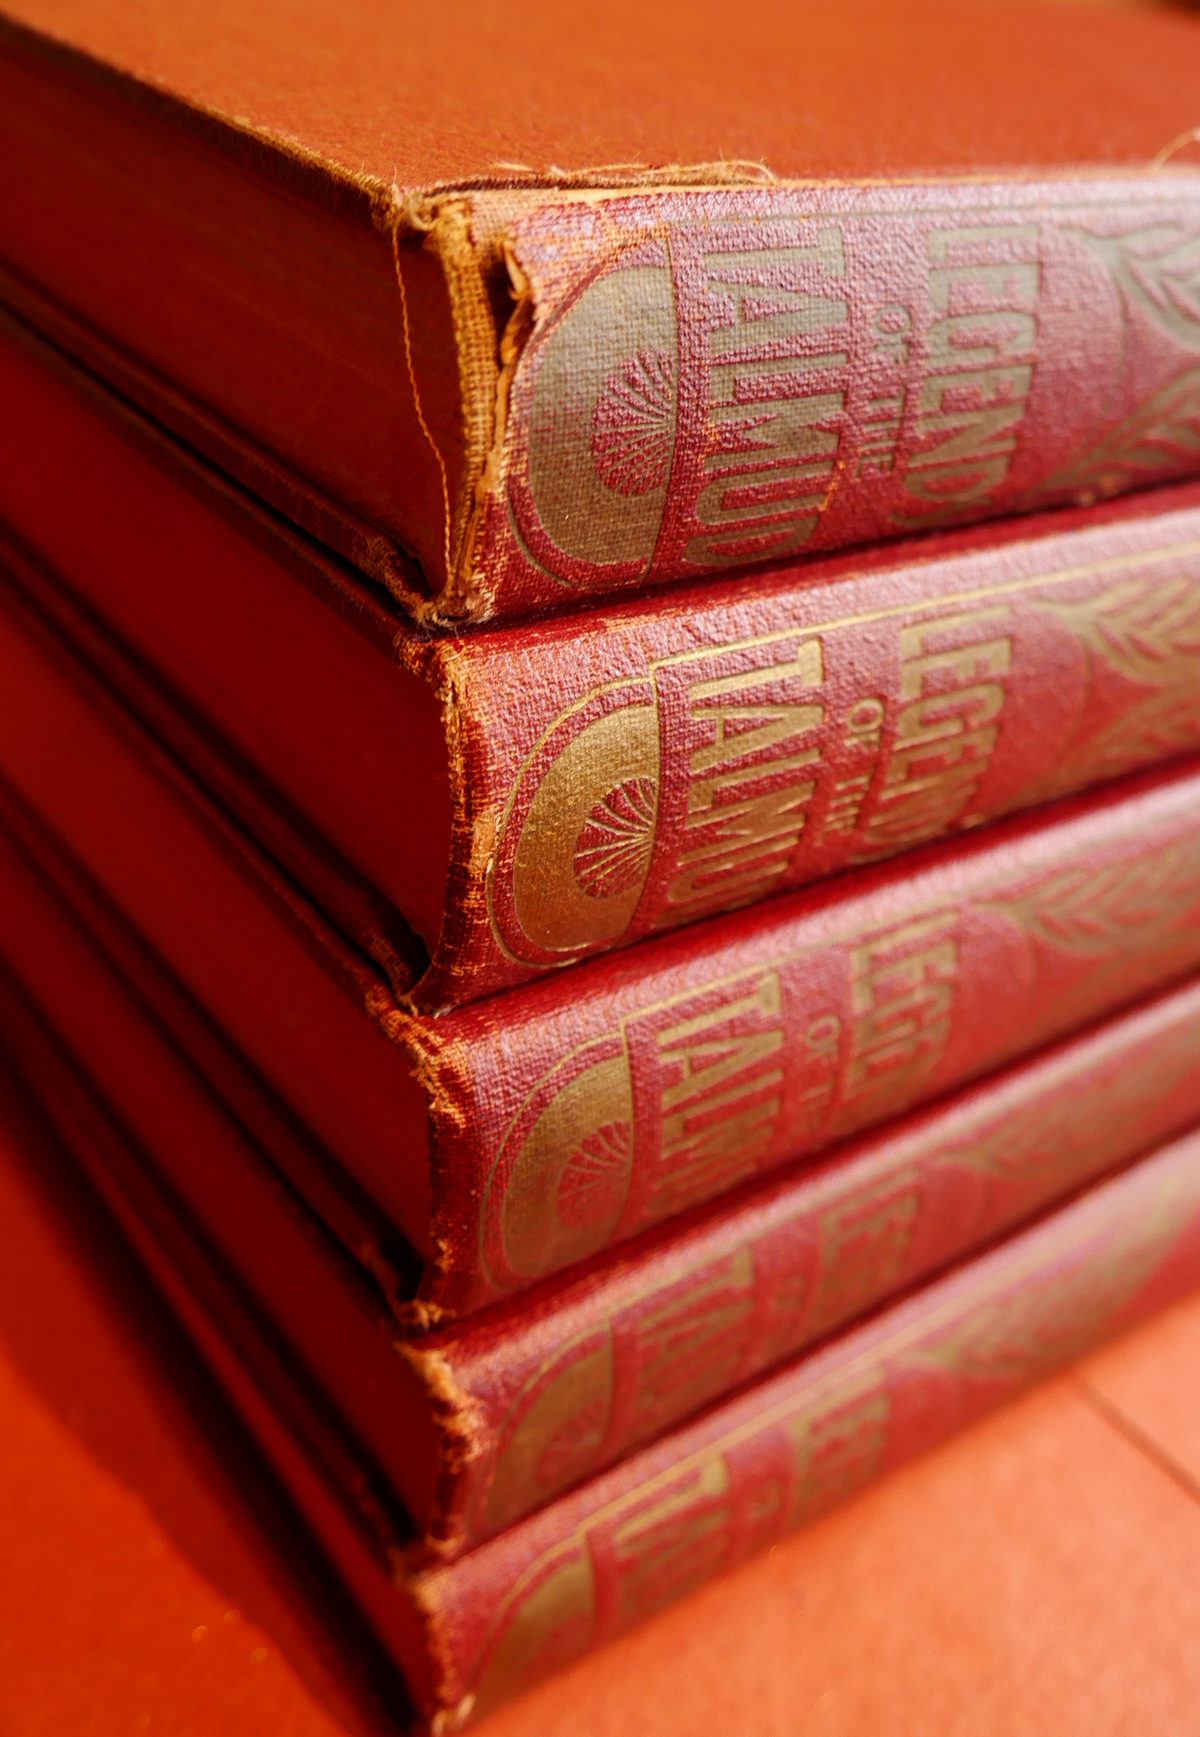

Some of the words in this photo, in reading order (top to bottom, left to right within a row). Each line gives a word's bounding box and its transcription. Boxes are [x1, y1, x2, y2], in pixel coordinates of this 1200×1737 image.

[873, 303, 912, 363] OF
[682, 225, 849, 567] TALMUD
[853, 385, 906, 479] THE
[845, 697, 886, 751] OF
